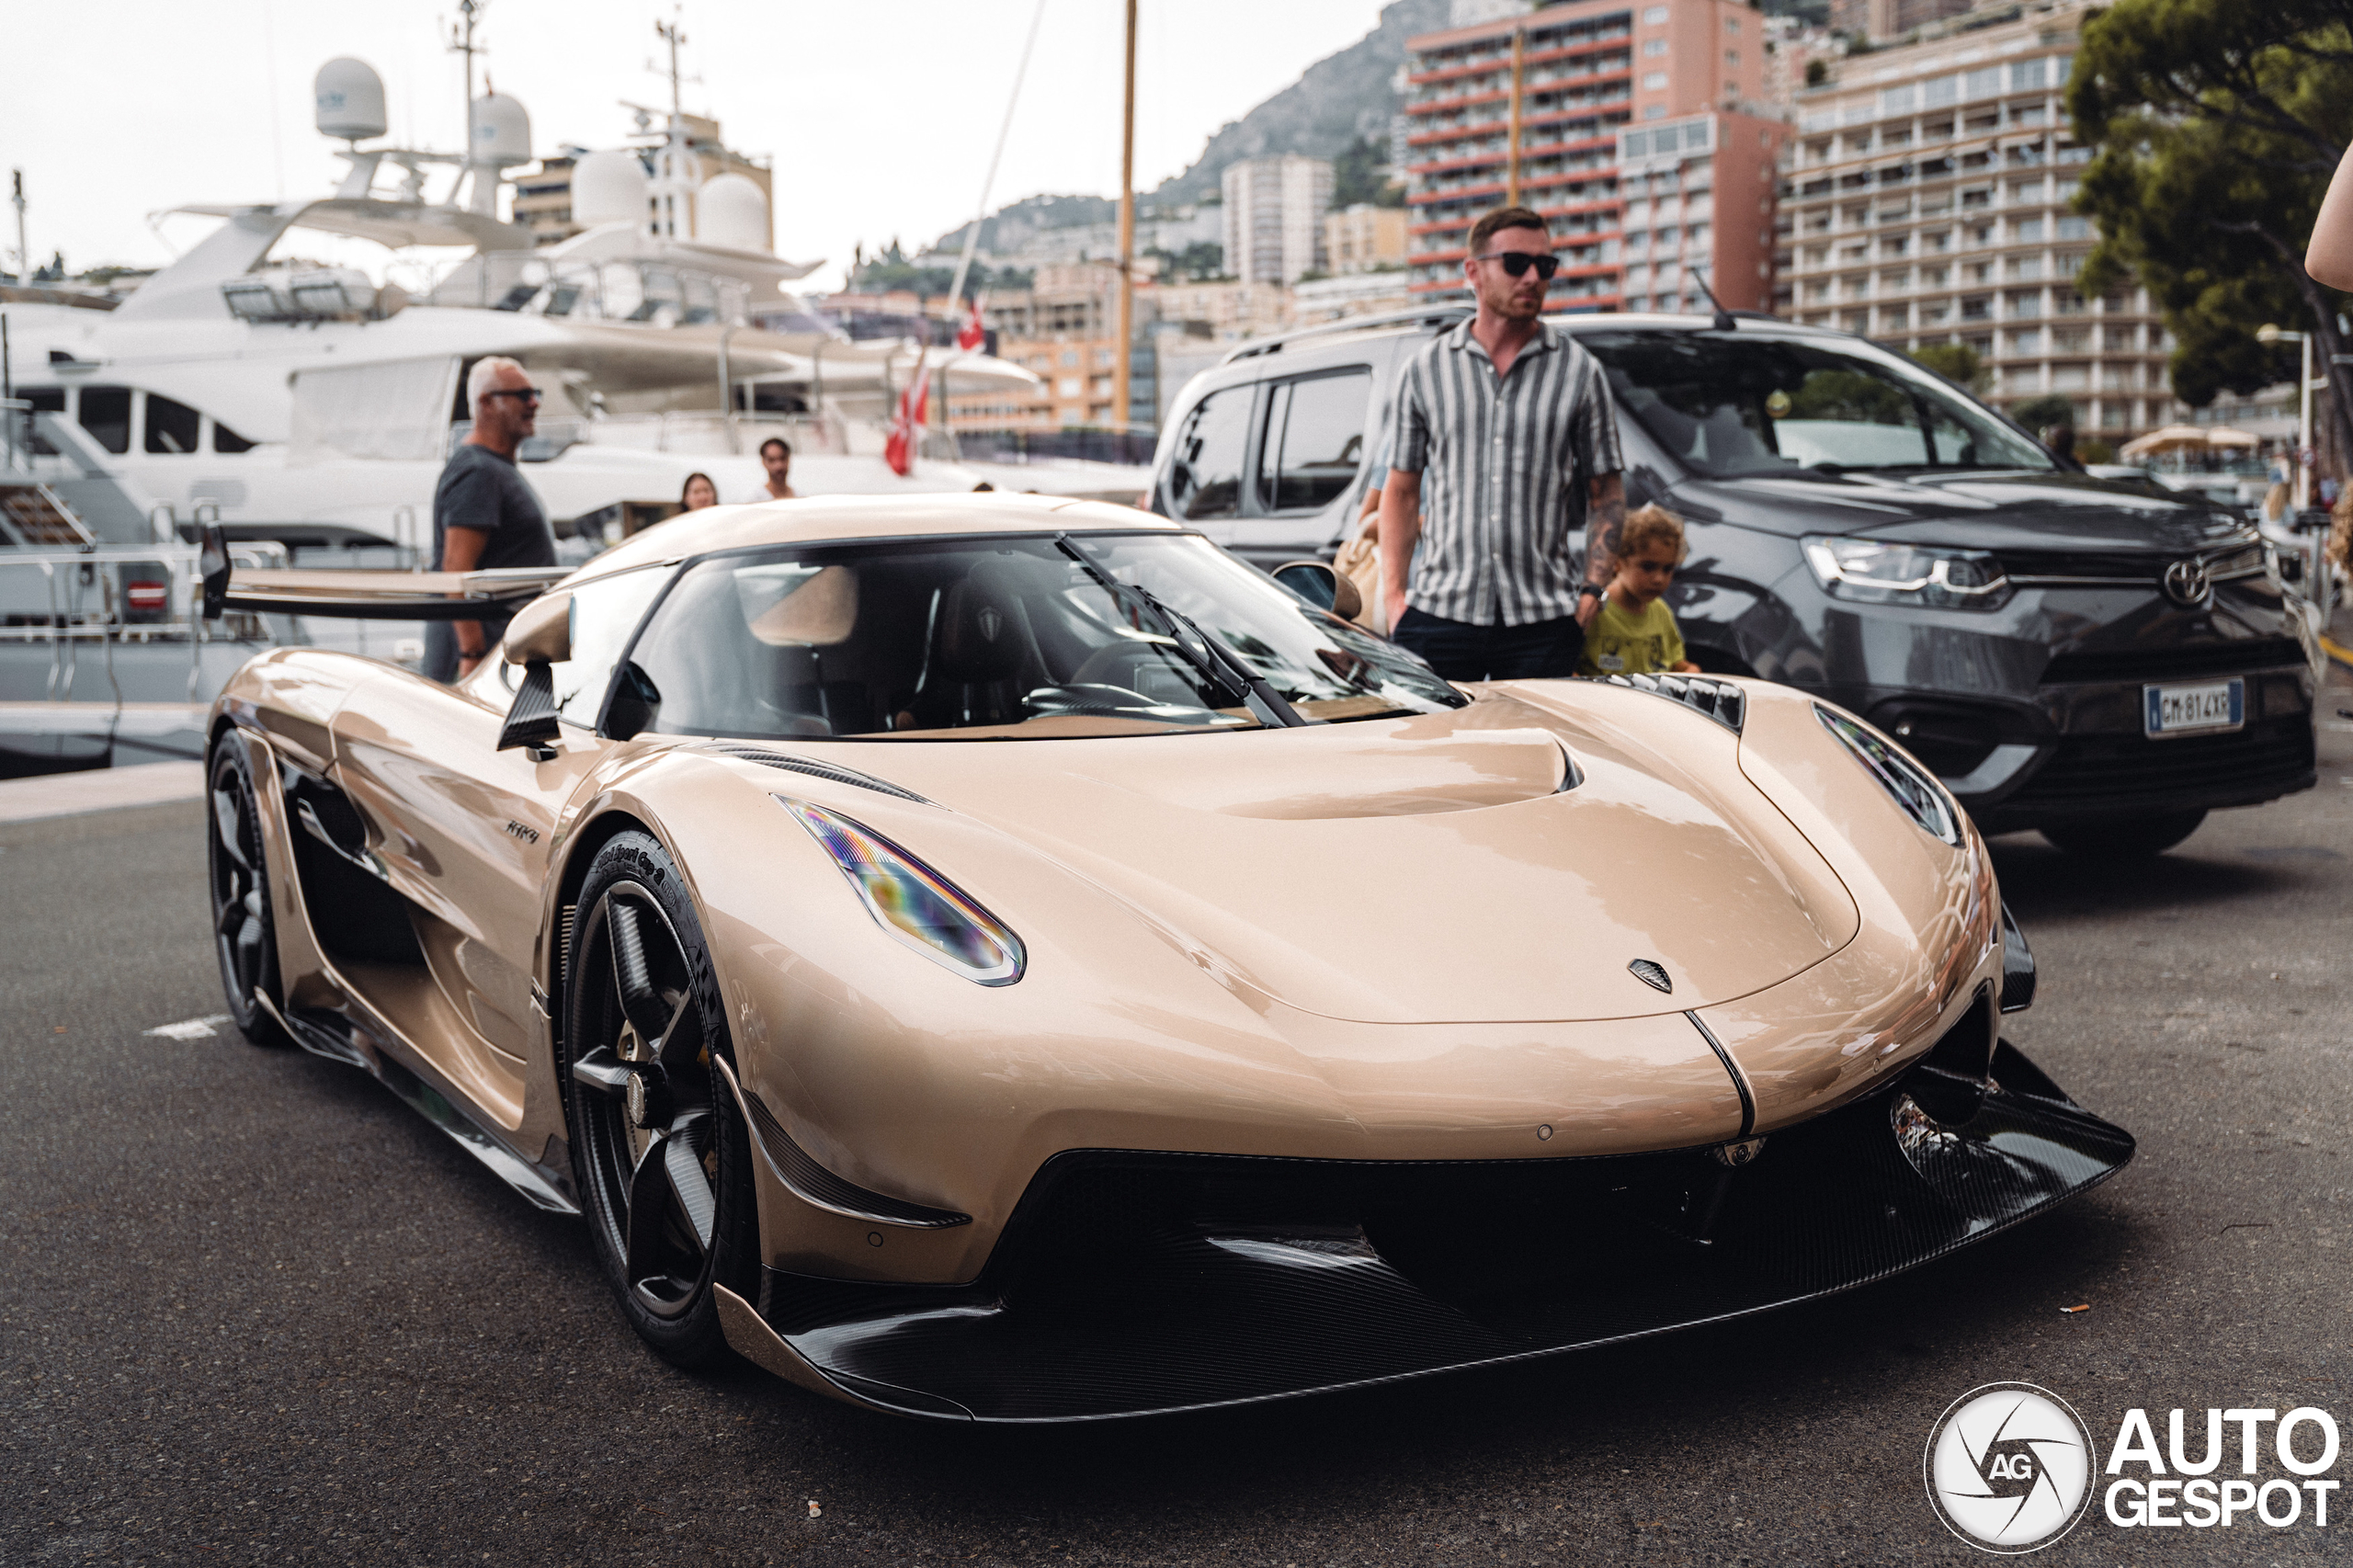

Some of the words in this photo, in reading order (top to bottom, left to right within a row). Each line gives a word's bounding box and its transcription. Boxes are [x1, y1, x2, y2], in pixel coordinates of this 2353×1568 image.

[613, 844, 640, 863] Sport
[638, 851, 654, 877] Cup
[654, 868, 665, 887] 2
